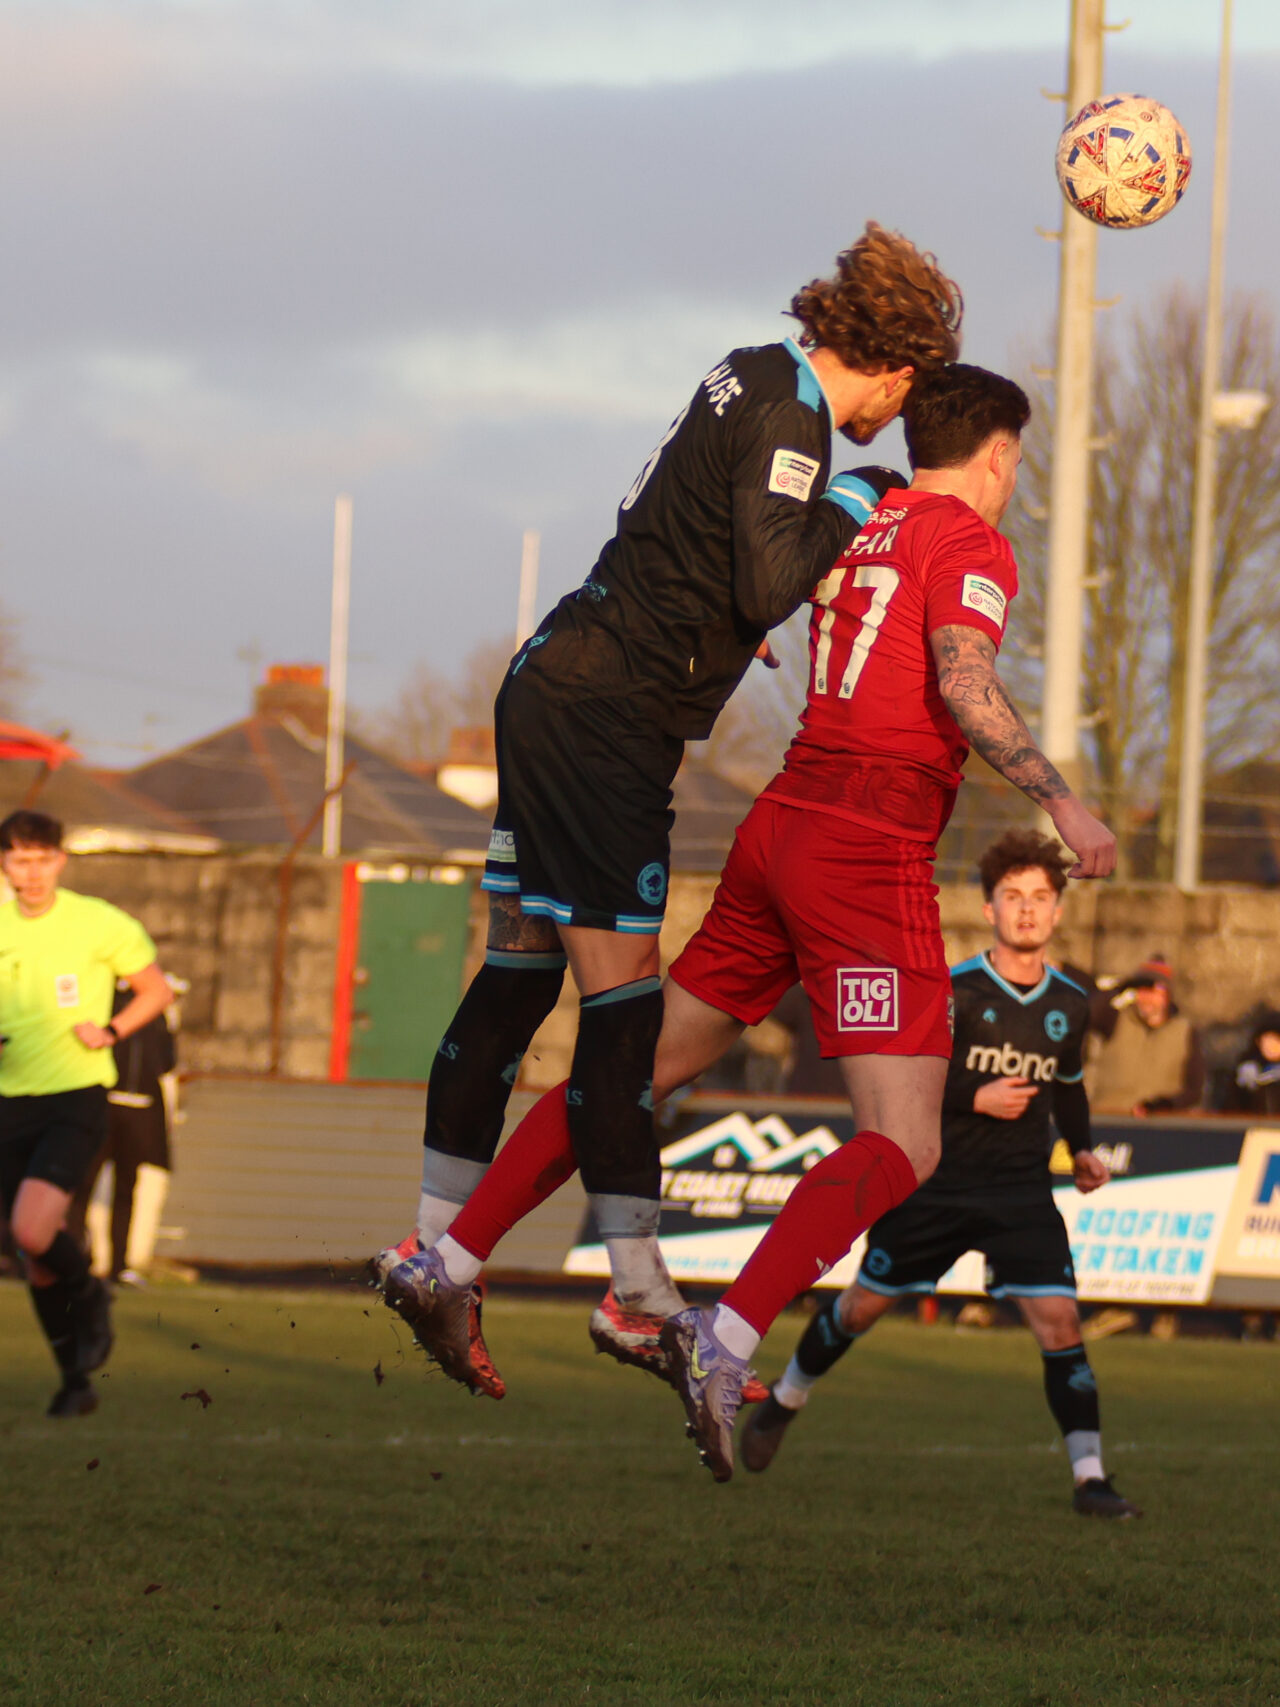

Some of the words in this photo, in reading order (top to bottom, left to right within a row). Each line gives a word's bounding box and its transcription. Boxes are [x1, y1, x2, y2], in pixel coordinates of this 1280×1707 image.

[814, 565, 900, 699] 17
[843, 978, 892, 1001] TIG
[843, 1000, 892, 1023] OLI
[1074, 1208, 1215, 1241] ROOFING
